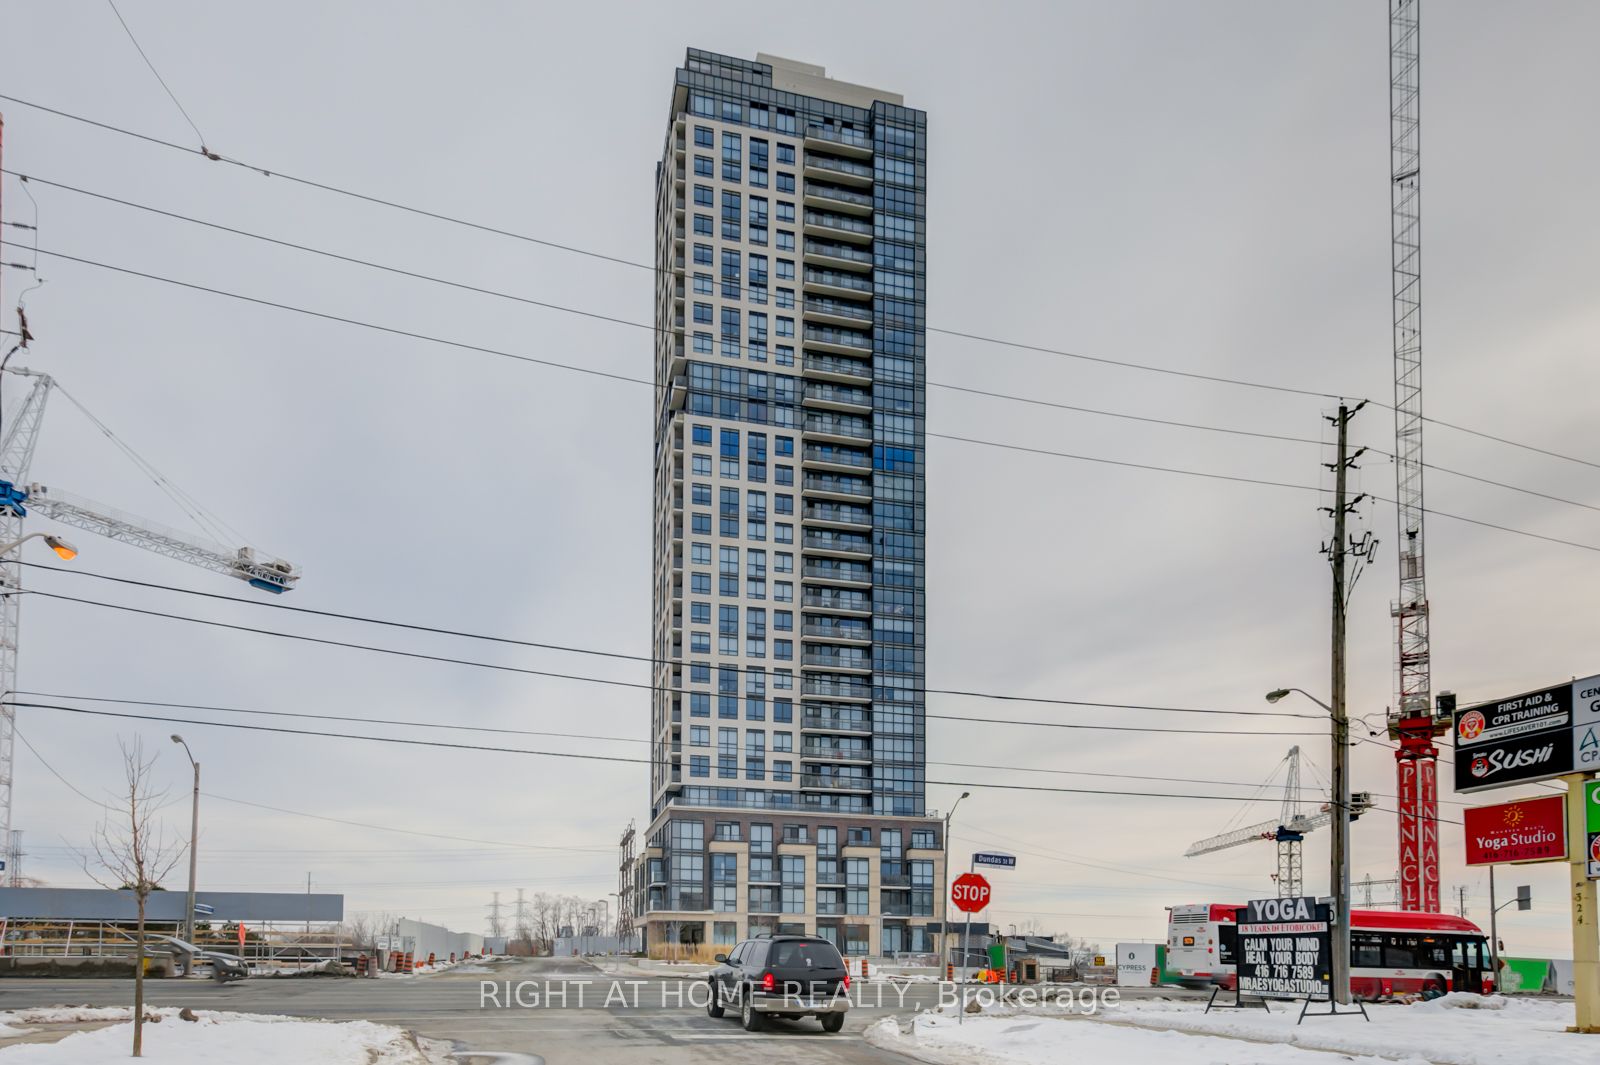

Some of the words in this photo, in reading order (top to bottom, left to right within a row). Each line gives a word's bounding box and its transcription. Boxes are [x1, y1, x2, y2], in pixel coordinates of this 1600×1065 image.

[1497, 700, 1524, 713] FIRST
[1525, 696, 1542, 707] AID
[1544, 693, 1553, 702] &
[1492, 714, 1510, 726] CPR
[1512, 703, 1559, 721] TRAINING
[1476, 836, 1509, 850] Yoga
[1510, 832, 1556, 846] Studio
[978, 855, 1001, 864] Dundas
[953, 884, 989, 902] STOP
[1252, 898, 1310, 921] YOGA
[1244, 937, 1267, 951] CALM
[1270, 937, 1293, 951] YOUR
[1295, 937, 1320, 951] MIND
[1245, 951, 1267, 964] HEAL
[1269, 951, 1293, 965] YOUR
[1295, 951, 1319, 966] BODY
[1254, 964, 1270, 977] 416
[1273, 965, 1289, 978] 716
[1291, 966, 1314, 979] 7589
